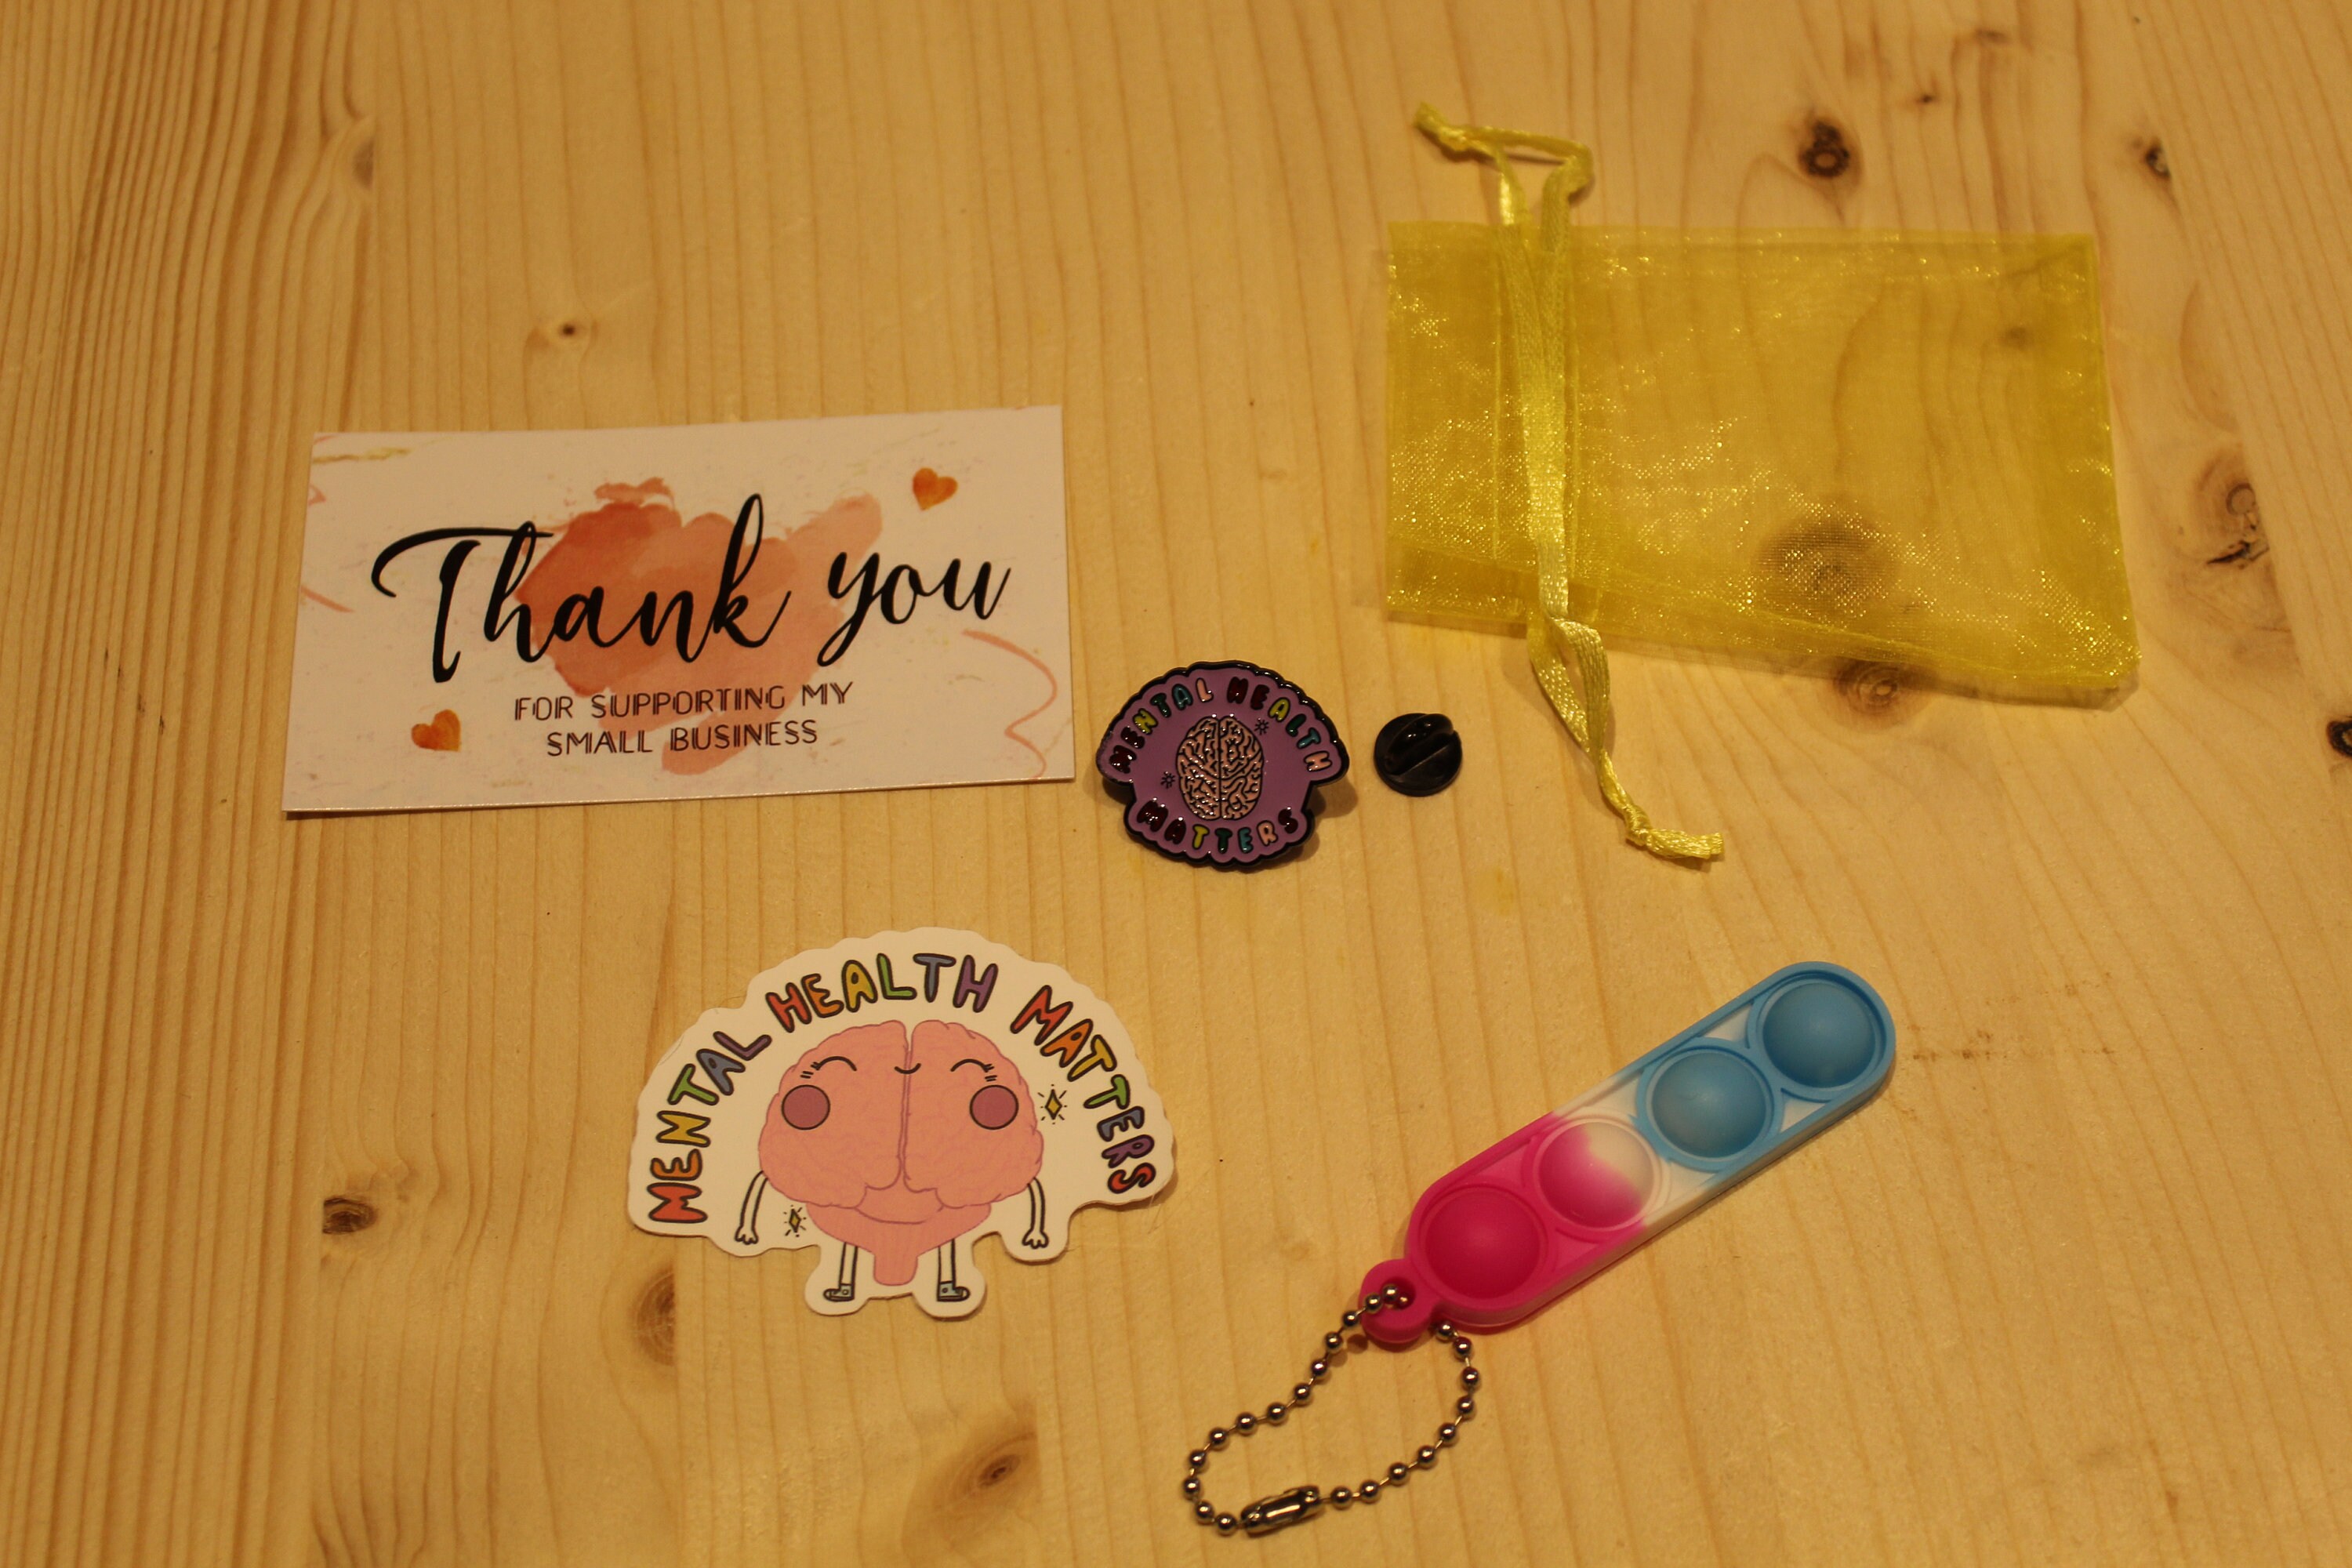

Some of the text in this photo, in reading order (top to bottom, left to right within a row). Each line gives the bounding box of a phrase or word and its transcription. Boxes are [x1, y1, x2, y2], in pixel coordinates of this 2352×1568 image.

[371, 493, 1011, 683] Thank you
[514, 681, 854, 721] FOR SUPPORTING MY
[547, 719, 818, 757] SMALL BUSINESS
[1109, 677, 1332, 774] MENTAL HEALTH
[1137, 799, 1298, 854] MATTERS
[648, 953, 1156, 1223] MENTAL HEALTH MATTERS
